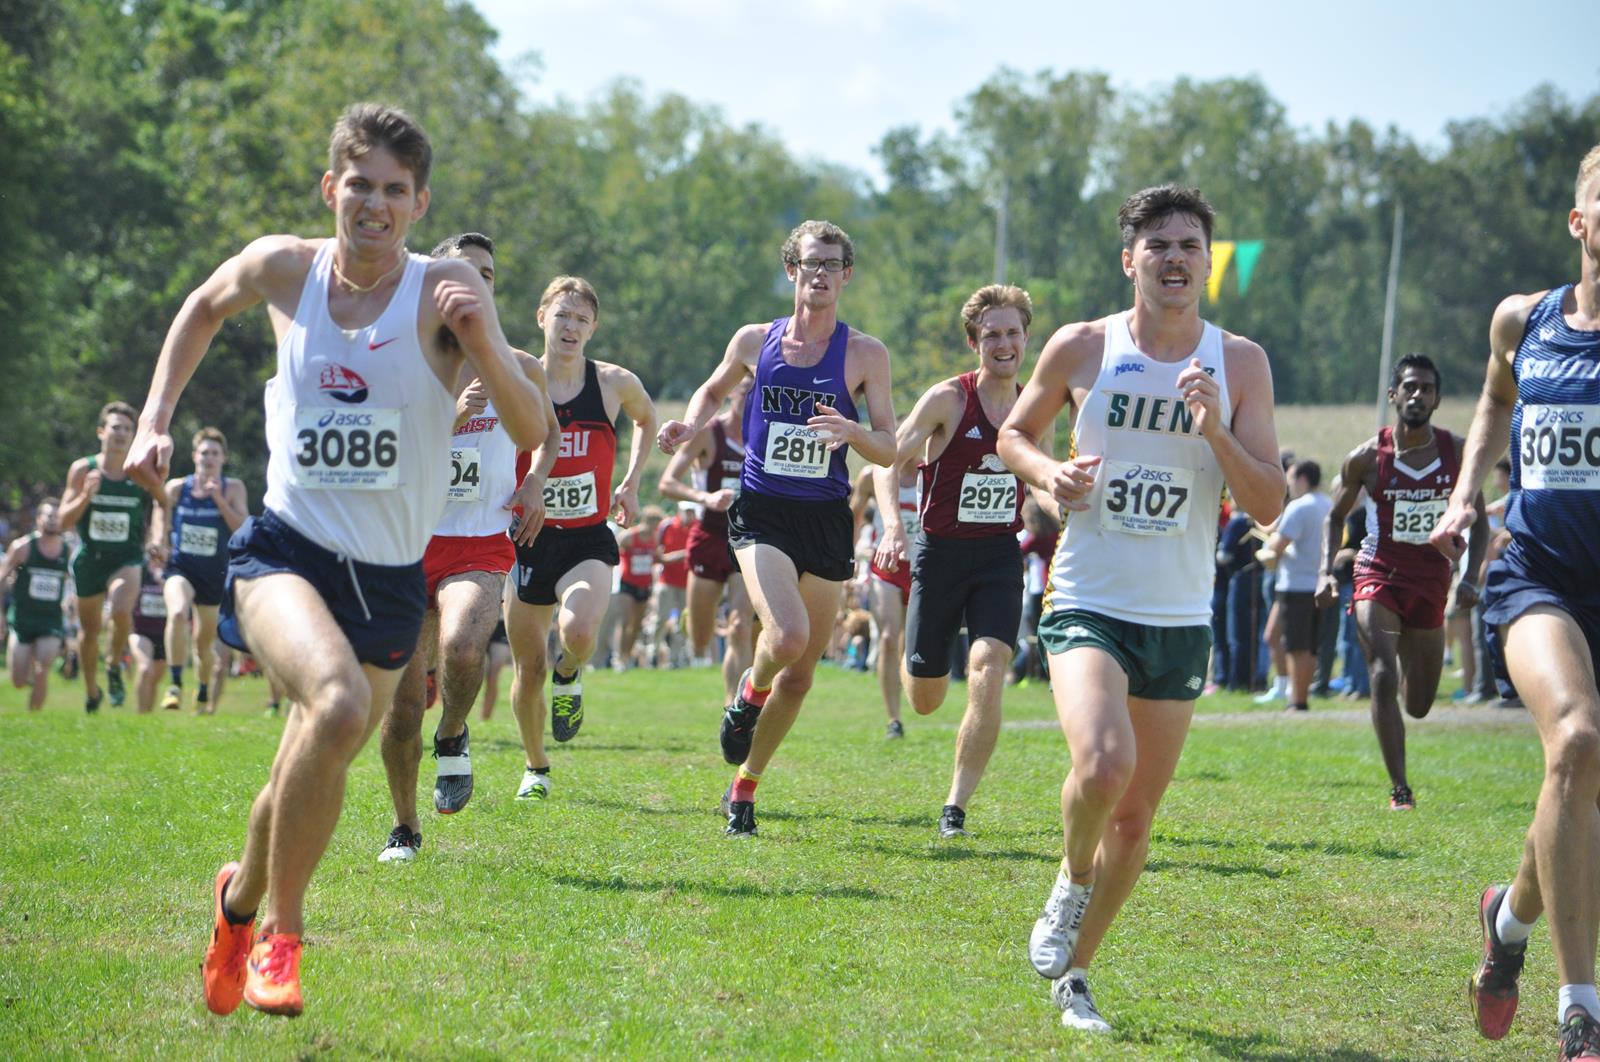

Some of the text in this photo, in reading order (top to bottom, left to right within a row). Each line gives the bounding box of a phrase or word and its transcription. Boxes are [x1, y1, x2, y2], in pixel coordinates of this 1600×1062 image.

[1114, 363, 1145, 376] MAAC
[761, 385, 836, 417] NYU
[336, 413, 373, 426] asics
[1107, 393, 1203, 436] SIEN
[1549, 411, 1584, 424] asics
[558, 430, 591, 458] SU
[795, 429, 818, 438] asics
[296, 428, 398, 467] 3086
[771, 436, 827, 464] 2811
[450, 459, 480, 486] 04
[1140, 468, 1173, 483] asics
[543, 484, 592, 508] 2187
[961, 485, 1016, 510] 2972
[1106, 478, 1188, 519] 3107
[1383, 487, 1453, 501] TEMPLE
